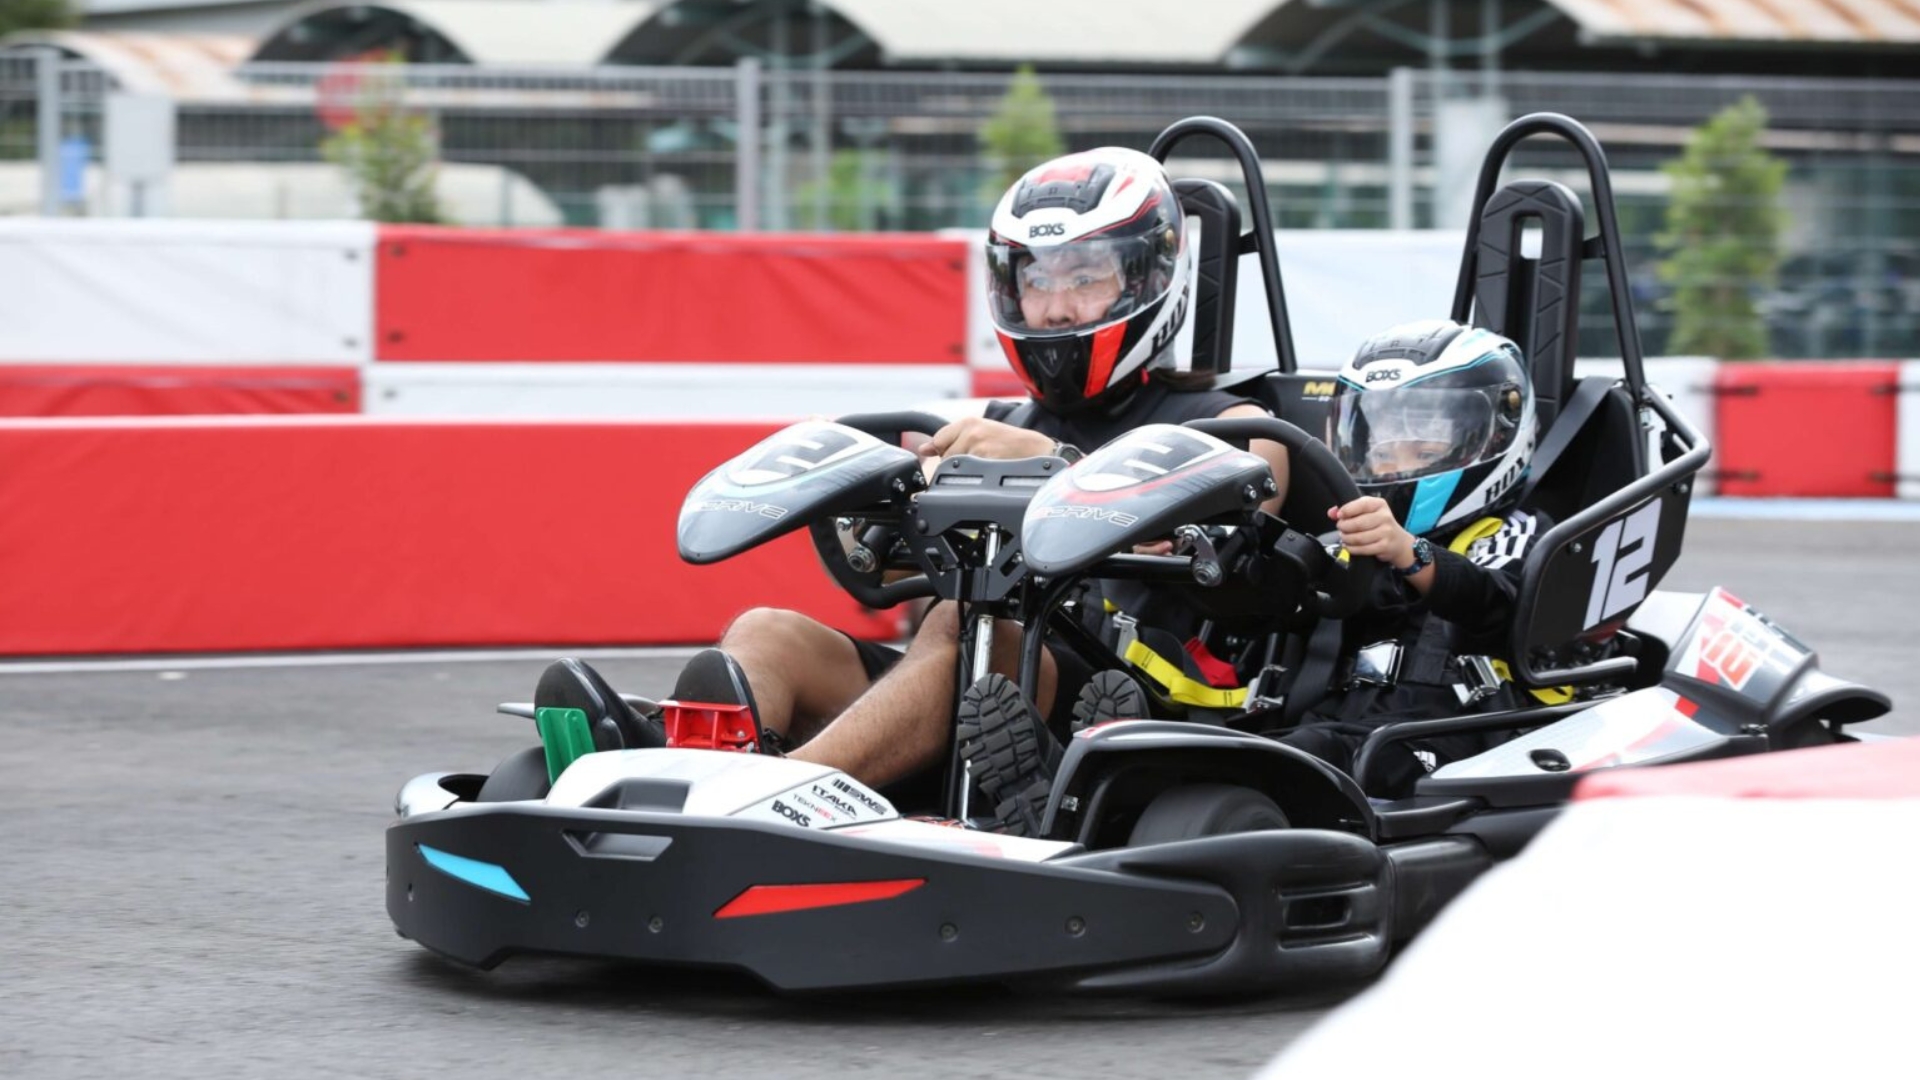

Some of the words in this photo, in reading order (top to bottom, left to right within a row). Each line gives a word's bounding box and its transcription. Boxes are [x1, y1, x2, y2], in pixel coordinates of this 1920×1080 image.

[1028, 222, 1066, 239] BOXS
[1365, 367, 1402, 384] BOXS
[1582, 497, 1663, 632] 12
[771, 799, 812, 828] BOXS
